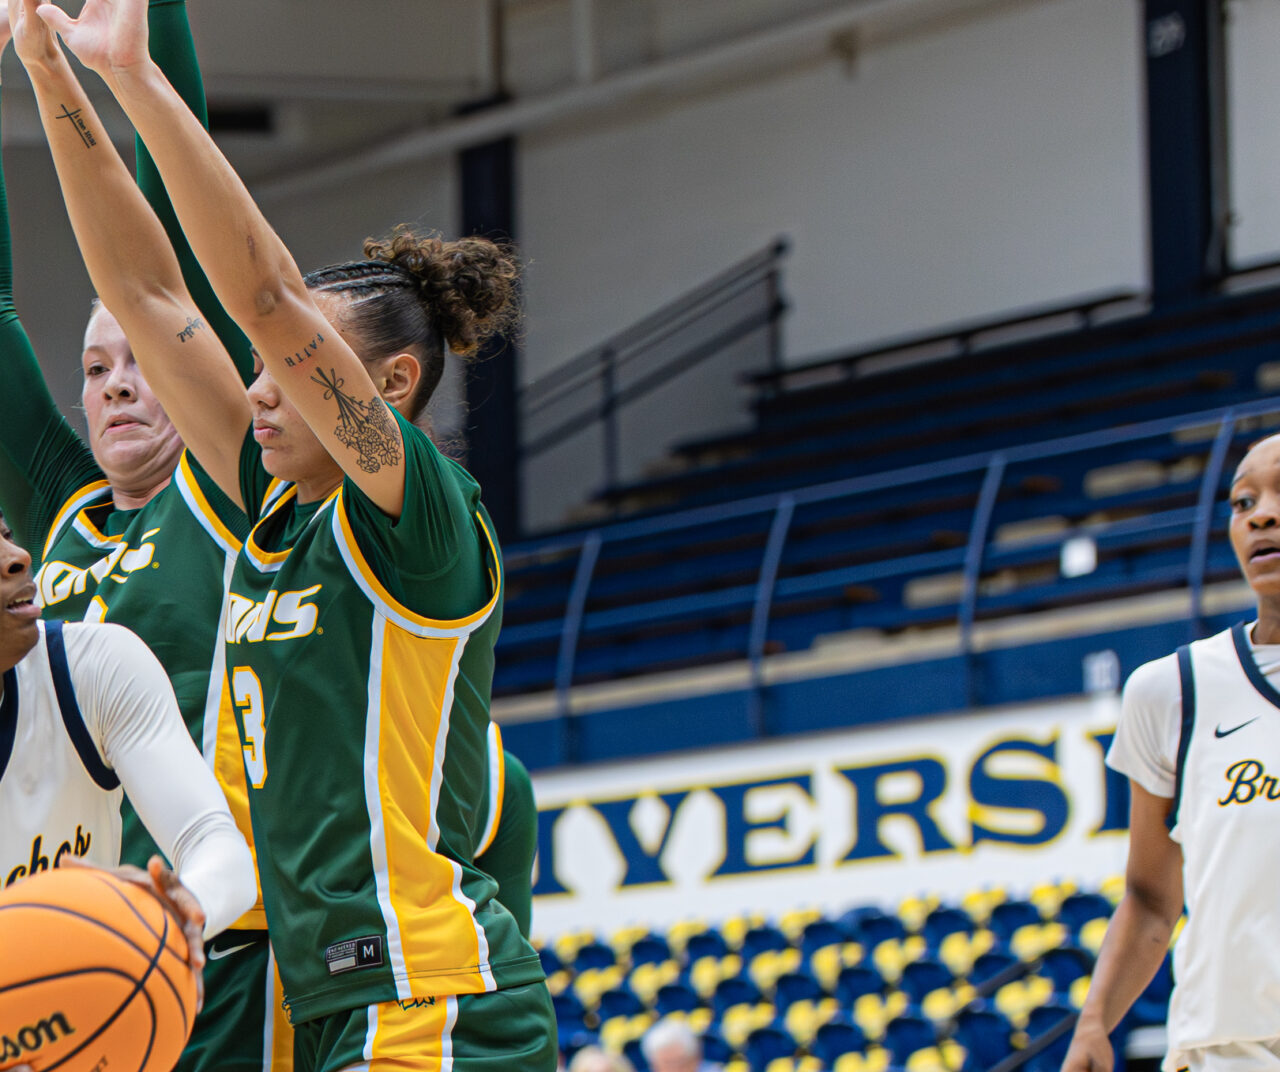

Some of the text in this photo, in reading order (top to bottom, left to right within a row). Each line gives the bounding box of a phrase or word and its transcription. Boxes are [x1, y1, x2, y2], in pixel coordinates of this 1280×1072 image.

[1217, 758, 1280, 808] Br
[532, 726, 1130, 899] IVERSI
[363, 944, 375, 958] M
